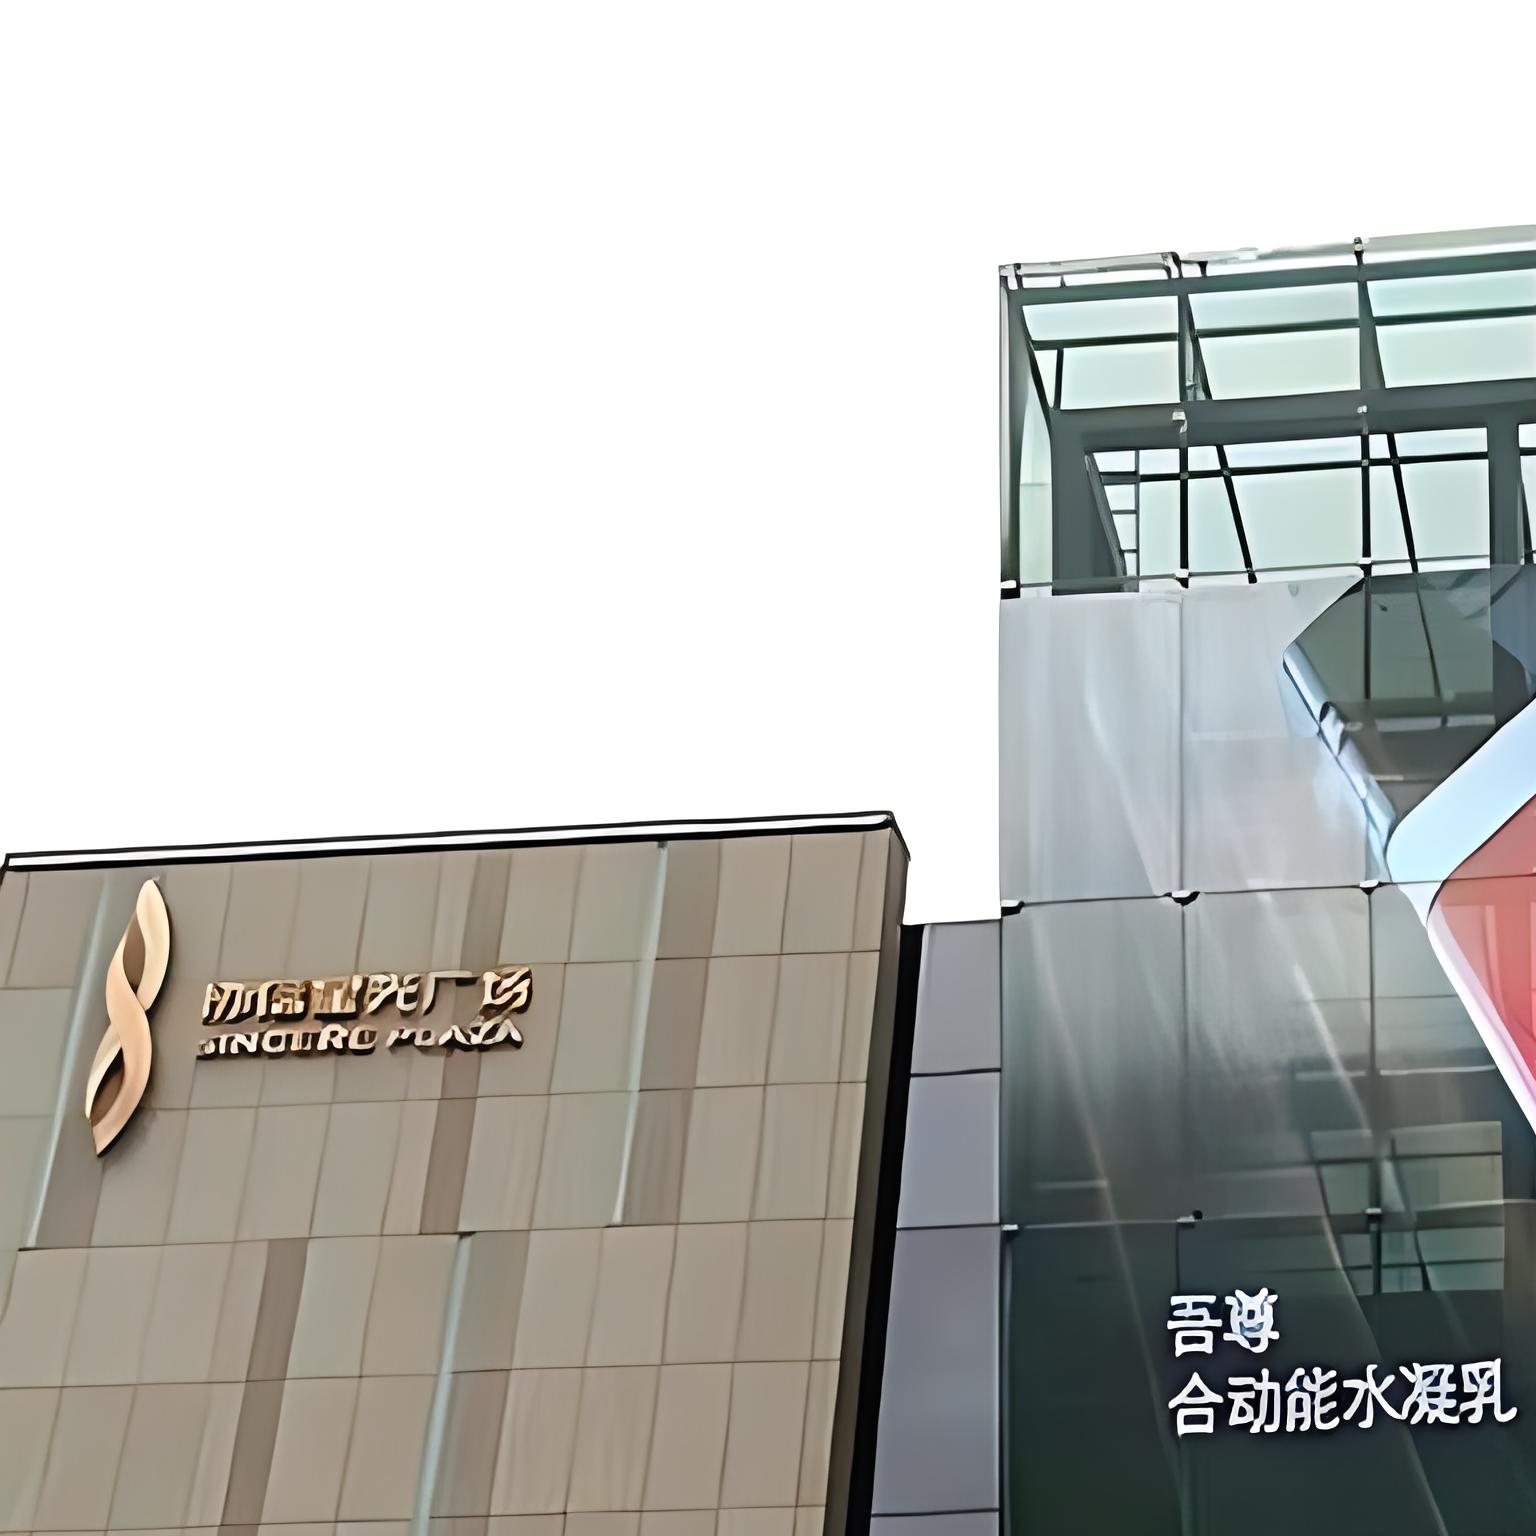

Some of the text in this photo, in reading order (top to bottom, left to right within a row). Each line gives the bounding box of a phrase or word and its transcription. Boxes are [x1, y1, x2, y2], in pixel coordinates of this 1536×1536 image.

[1166, 1287, 1280, 1357] 吾尊
[1168, 1357, 1518, 1439] 合动能水凝乳
